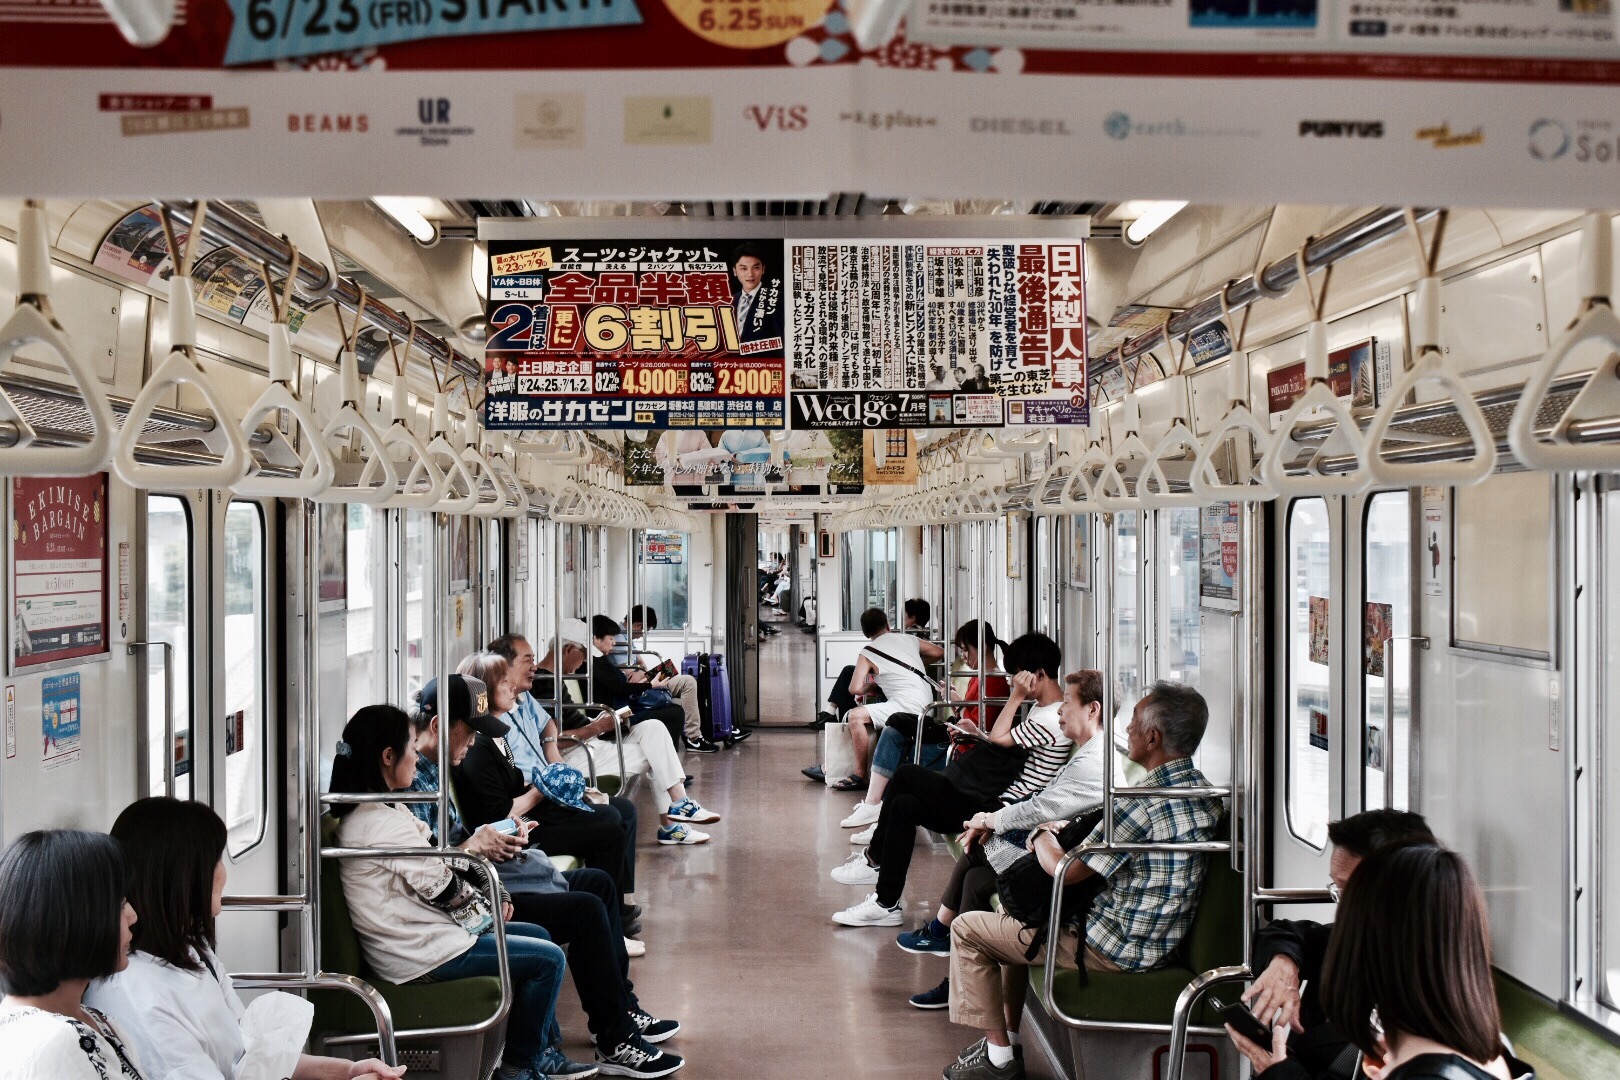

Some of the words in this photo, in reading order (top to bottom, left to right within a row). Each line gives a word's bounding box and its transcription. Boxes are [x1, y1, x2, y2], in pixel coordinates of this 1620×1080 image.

[698, 9, 762, 31] 6.25
[765, 15, 804, 31] SUN
[287, 114, 369, 132] BEAMS
[418, 97, 452, 124] UR
[743, 103, 809, 132] ViS
[969, 116, 1071, 136] DIESEL
[1299, 120, 1384, 138] PUNYUS
[496, 250, 545, 264] 夏の大バーゲン
[562, 247, 719, 262] スーツ・ジャケット
[928, 247, 982, 256] 経営者の育て方
[544, 271, 734, 305] 全品半額
[934, 257, 945, 298] 坂本幸雄
[766, 278, 781, 315] サカゼン
[1002, 245, 1017, 370] 型破りな経営者を育て
[1017, 245, 1048, 367] 最後通告
[484, 303, 534, 351] 2
[553, 310, 574, 345] 更に
[583, 305, 740, 352] 6割引
[936, 301, 946, 356] 若い力を生かす
[957, 301, 966, 356] 40歳までに習得
[976, 301, 986, 332] 30代から
[1050, 246, 1085, 408] 日本型人事への
[927, 301, 938, 371] 40代定年制の導入を
[948, 301, 958, 369] すべき13の必須科目
[967, 301, 978, 363] 修羅場に送り出せ
[740, 339, 782, 354] 他社圧倒!
[519, 361, 593, 375] 土日限定企画
[713, 361, 739, 369] ジャケット
[989, 369, 1051, 386] 第二の東芝
[595, 372, 620, 392] 82%
[622, 369, 677, 395] 4,900
[690, 372, 715, 392] 83%
[718, 369, 772, 395] 2,900
[995, 381, 1048, 397] を生むな!
[488, 400, 634, 422] 洋服のサカゼン
[637, 413, 652, 421] 検索
[726, 401, 753, 411] 渋谷店
[794, 394, 897, 427] Wedge
[1026, 404, 1072, 415] マキャベリの
[28, 485, 90, 523] EKIMISE
[33, 509, 85, 541] BARGAIN
